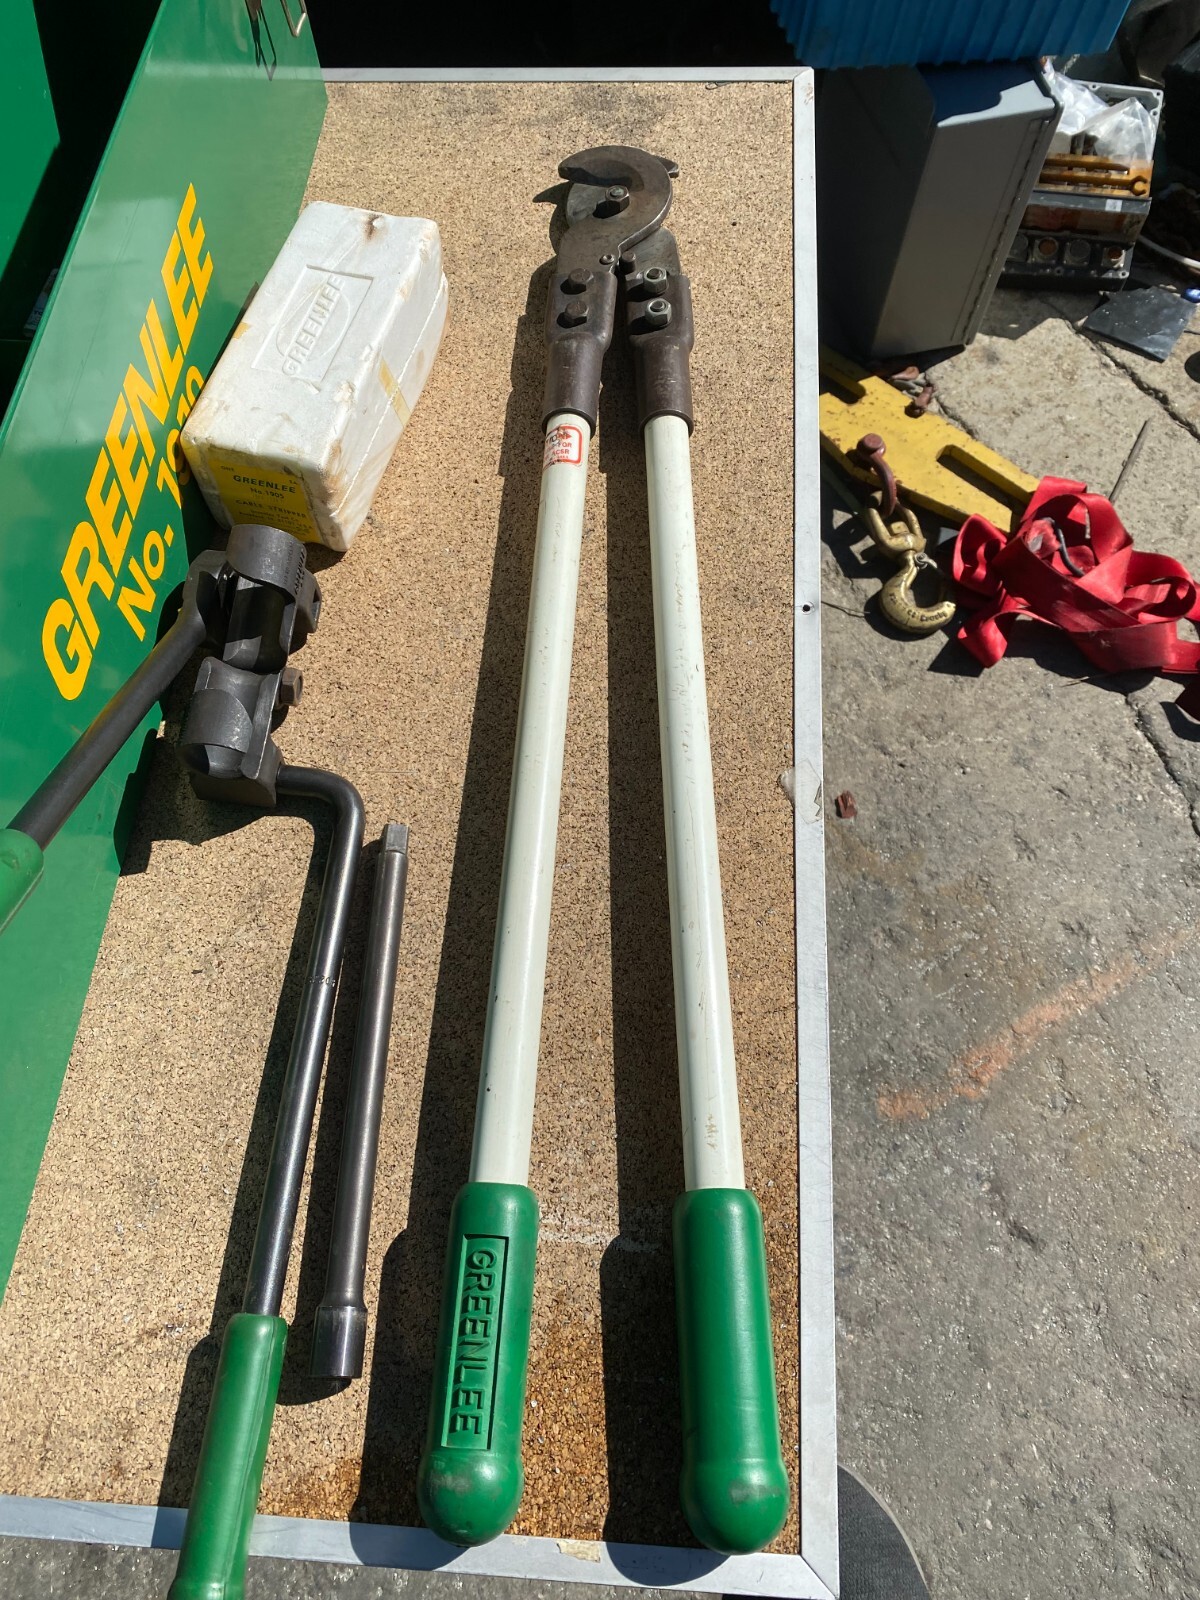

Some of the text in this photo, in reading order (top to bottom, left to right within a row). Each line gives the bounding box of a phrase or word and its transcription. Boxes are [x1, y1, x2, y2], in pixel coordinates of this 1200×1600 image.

[281, 274, 345, 376] GREENLEE
[42, 183, 213, 700] GREENLEE
[233, 475, 296, 494] GREENLEE
[452, 1249, 497, 1436] GREENLEE
